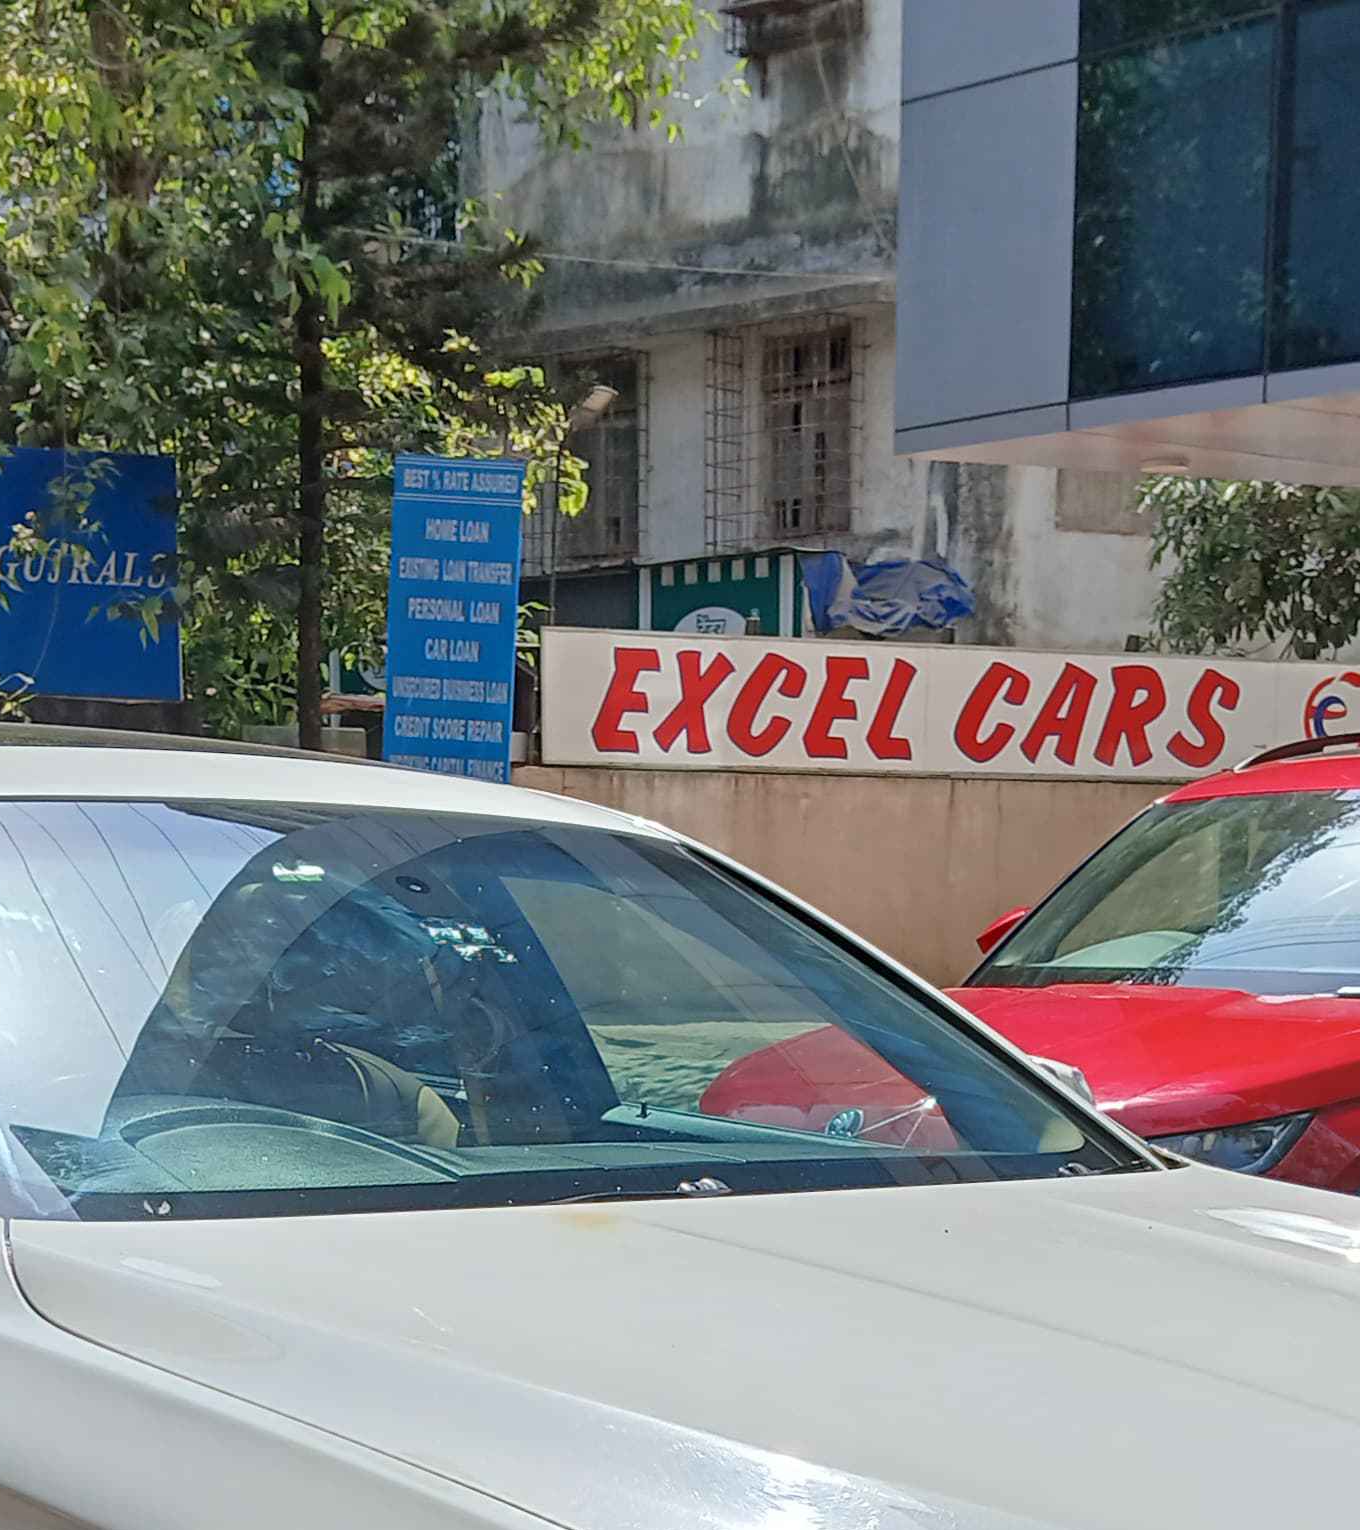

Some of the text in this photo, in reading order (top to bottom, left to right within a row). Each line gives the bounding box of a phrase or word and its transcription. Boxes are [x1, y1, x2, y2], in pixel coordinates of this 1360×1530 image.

[403, 468, 430, 488] BEST
[442, 470, 470, 491] RATE
[471, 472, 519, 494] ASSURED
[425, 518, 490, 543] HOME LOAN
[442, 558, 467, 582] LOAN
[468, 560, 513, 585] TRANSFER
[407, 597, 500, 624] PERSONAL LOAN
[425, 638, 480, 662] CAR LOAN
[486, 681, 509, 704] LOAN
[591, 646, 1240, 768] EXCEL CARS
[394, 715, 504, 743] CREDIT SCORE REPAIR
